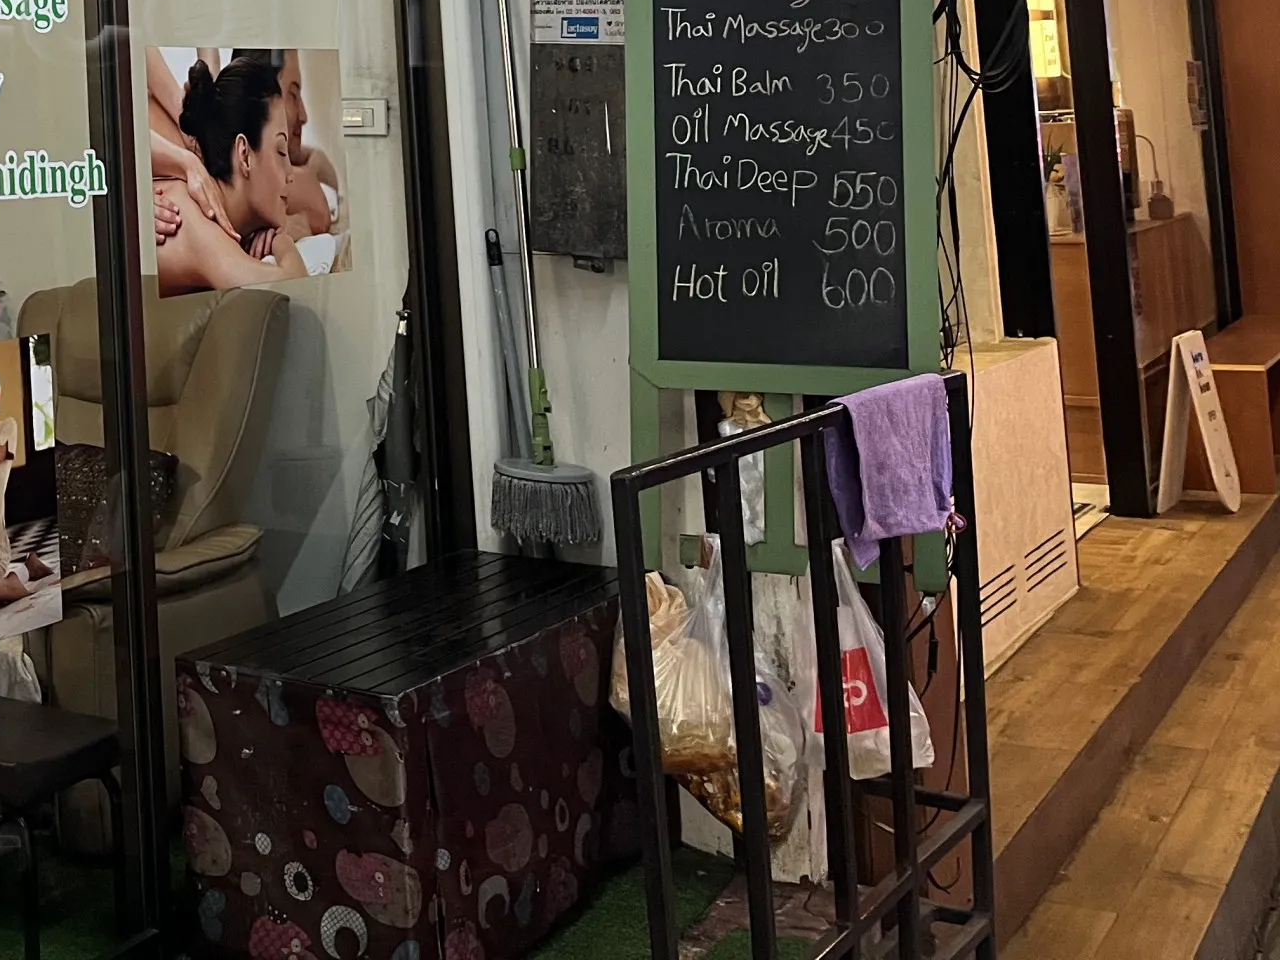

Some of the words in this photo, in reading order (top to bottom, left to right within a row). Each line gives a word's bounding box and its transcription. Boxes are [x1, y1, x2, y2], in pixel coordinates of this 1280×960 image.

[561, 20, 598, 38] Lactasoy
[661, 7, 715, 41] Thai
[724, 14, 825, 53] Massage
[825, 19, 886, 40] 300
[664, 63, 722, 98] Thai
[732, 67, 793, 97] Balm
[816, 73, 890, 104] 350
[672, 102, 710, 144] Oil
[724, 113, 832, 156] Massage
[831, 116, 895, 151] 450
[666, 153, 731, 191] Thai
[737, 159, 817, 206] Deep
[828, 171, 898, 209] 550
[678, 204, 781, 241] Aroma
[813, 217, 897, 254] 500
[672, 264, 728, 303] Hot
[822, 267, 896, 309] 600
